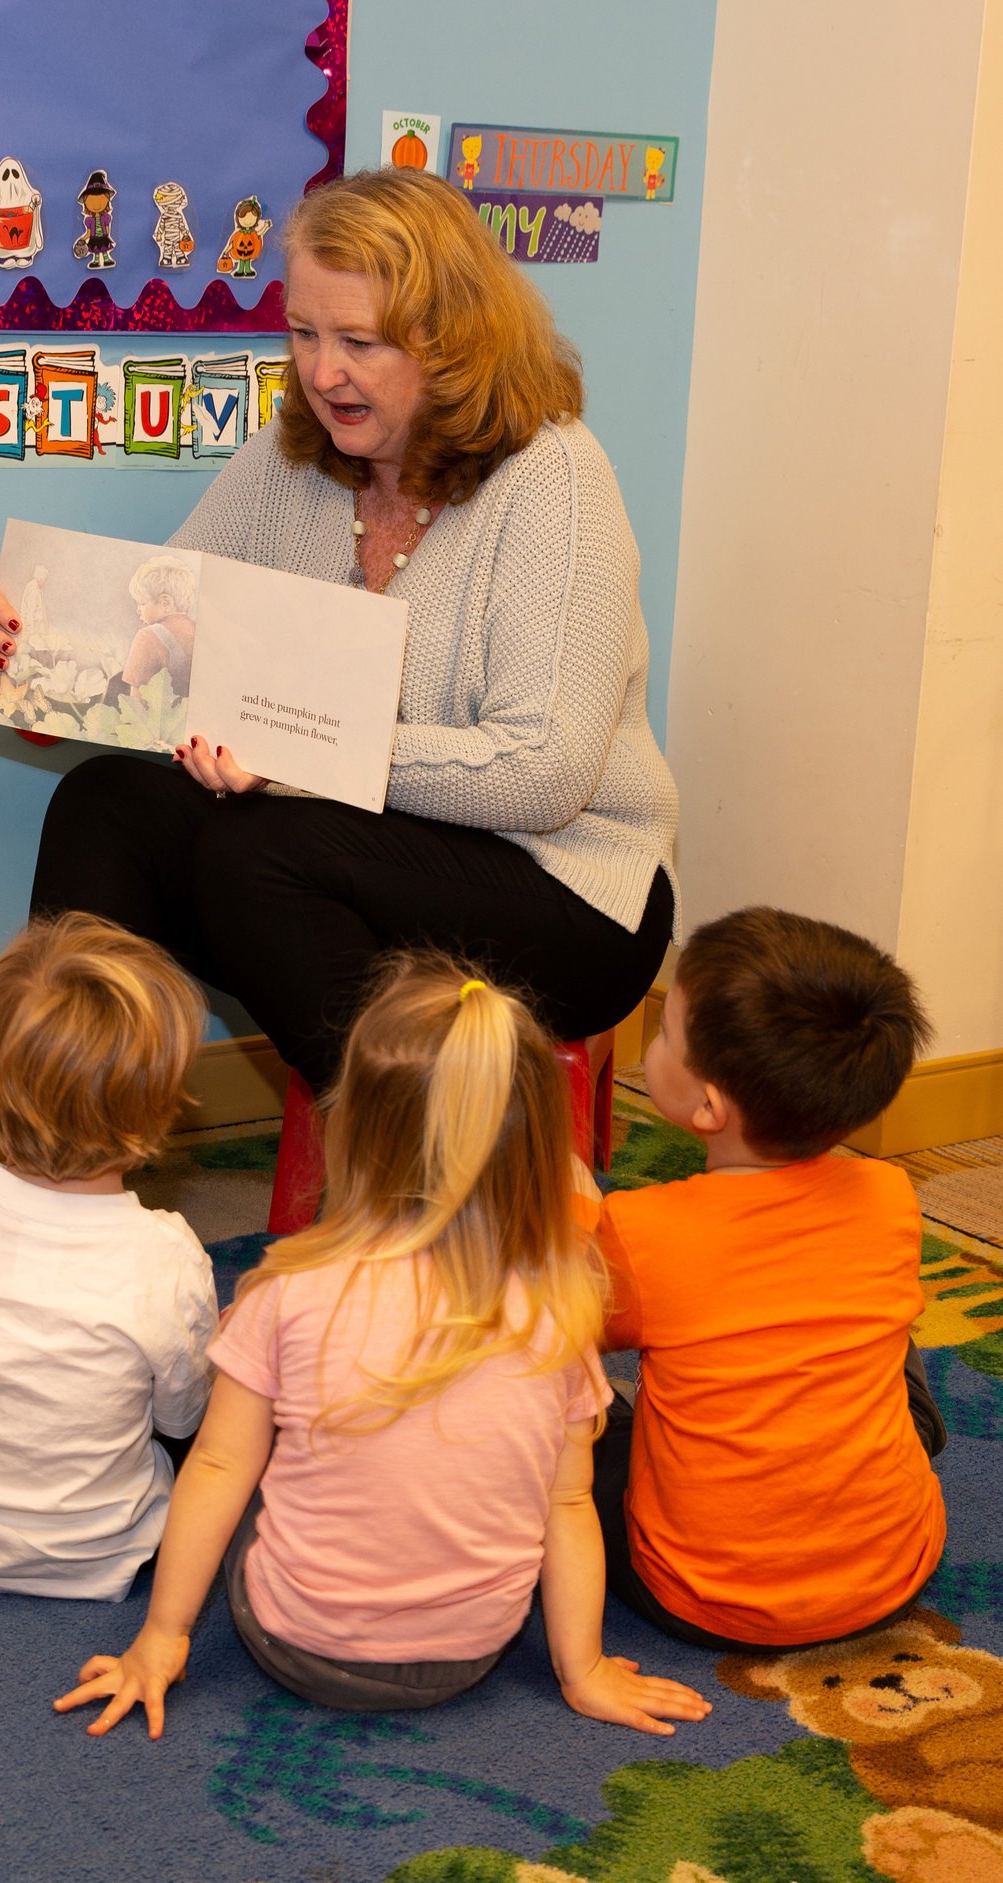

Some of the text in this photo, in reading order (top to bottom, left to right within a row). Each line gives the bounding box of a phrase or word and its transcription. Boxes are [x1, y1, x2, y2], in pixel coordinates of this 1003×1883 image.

[393, 118, 431, 134] OCTOBER
[491, 134, 637, 193] THURSDAY
[51, 382, 88, 437] T
[142, 390, 173, 437] U
[202, 392, 240, 442] V
[240, 710, 262, 723] grew
[270, 719, 309, 737] pumpkin
[310, 727, 338, 747] flower,
[241, 693, 341, 728] and the pumpkin plant
